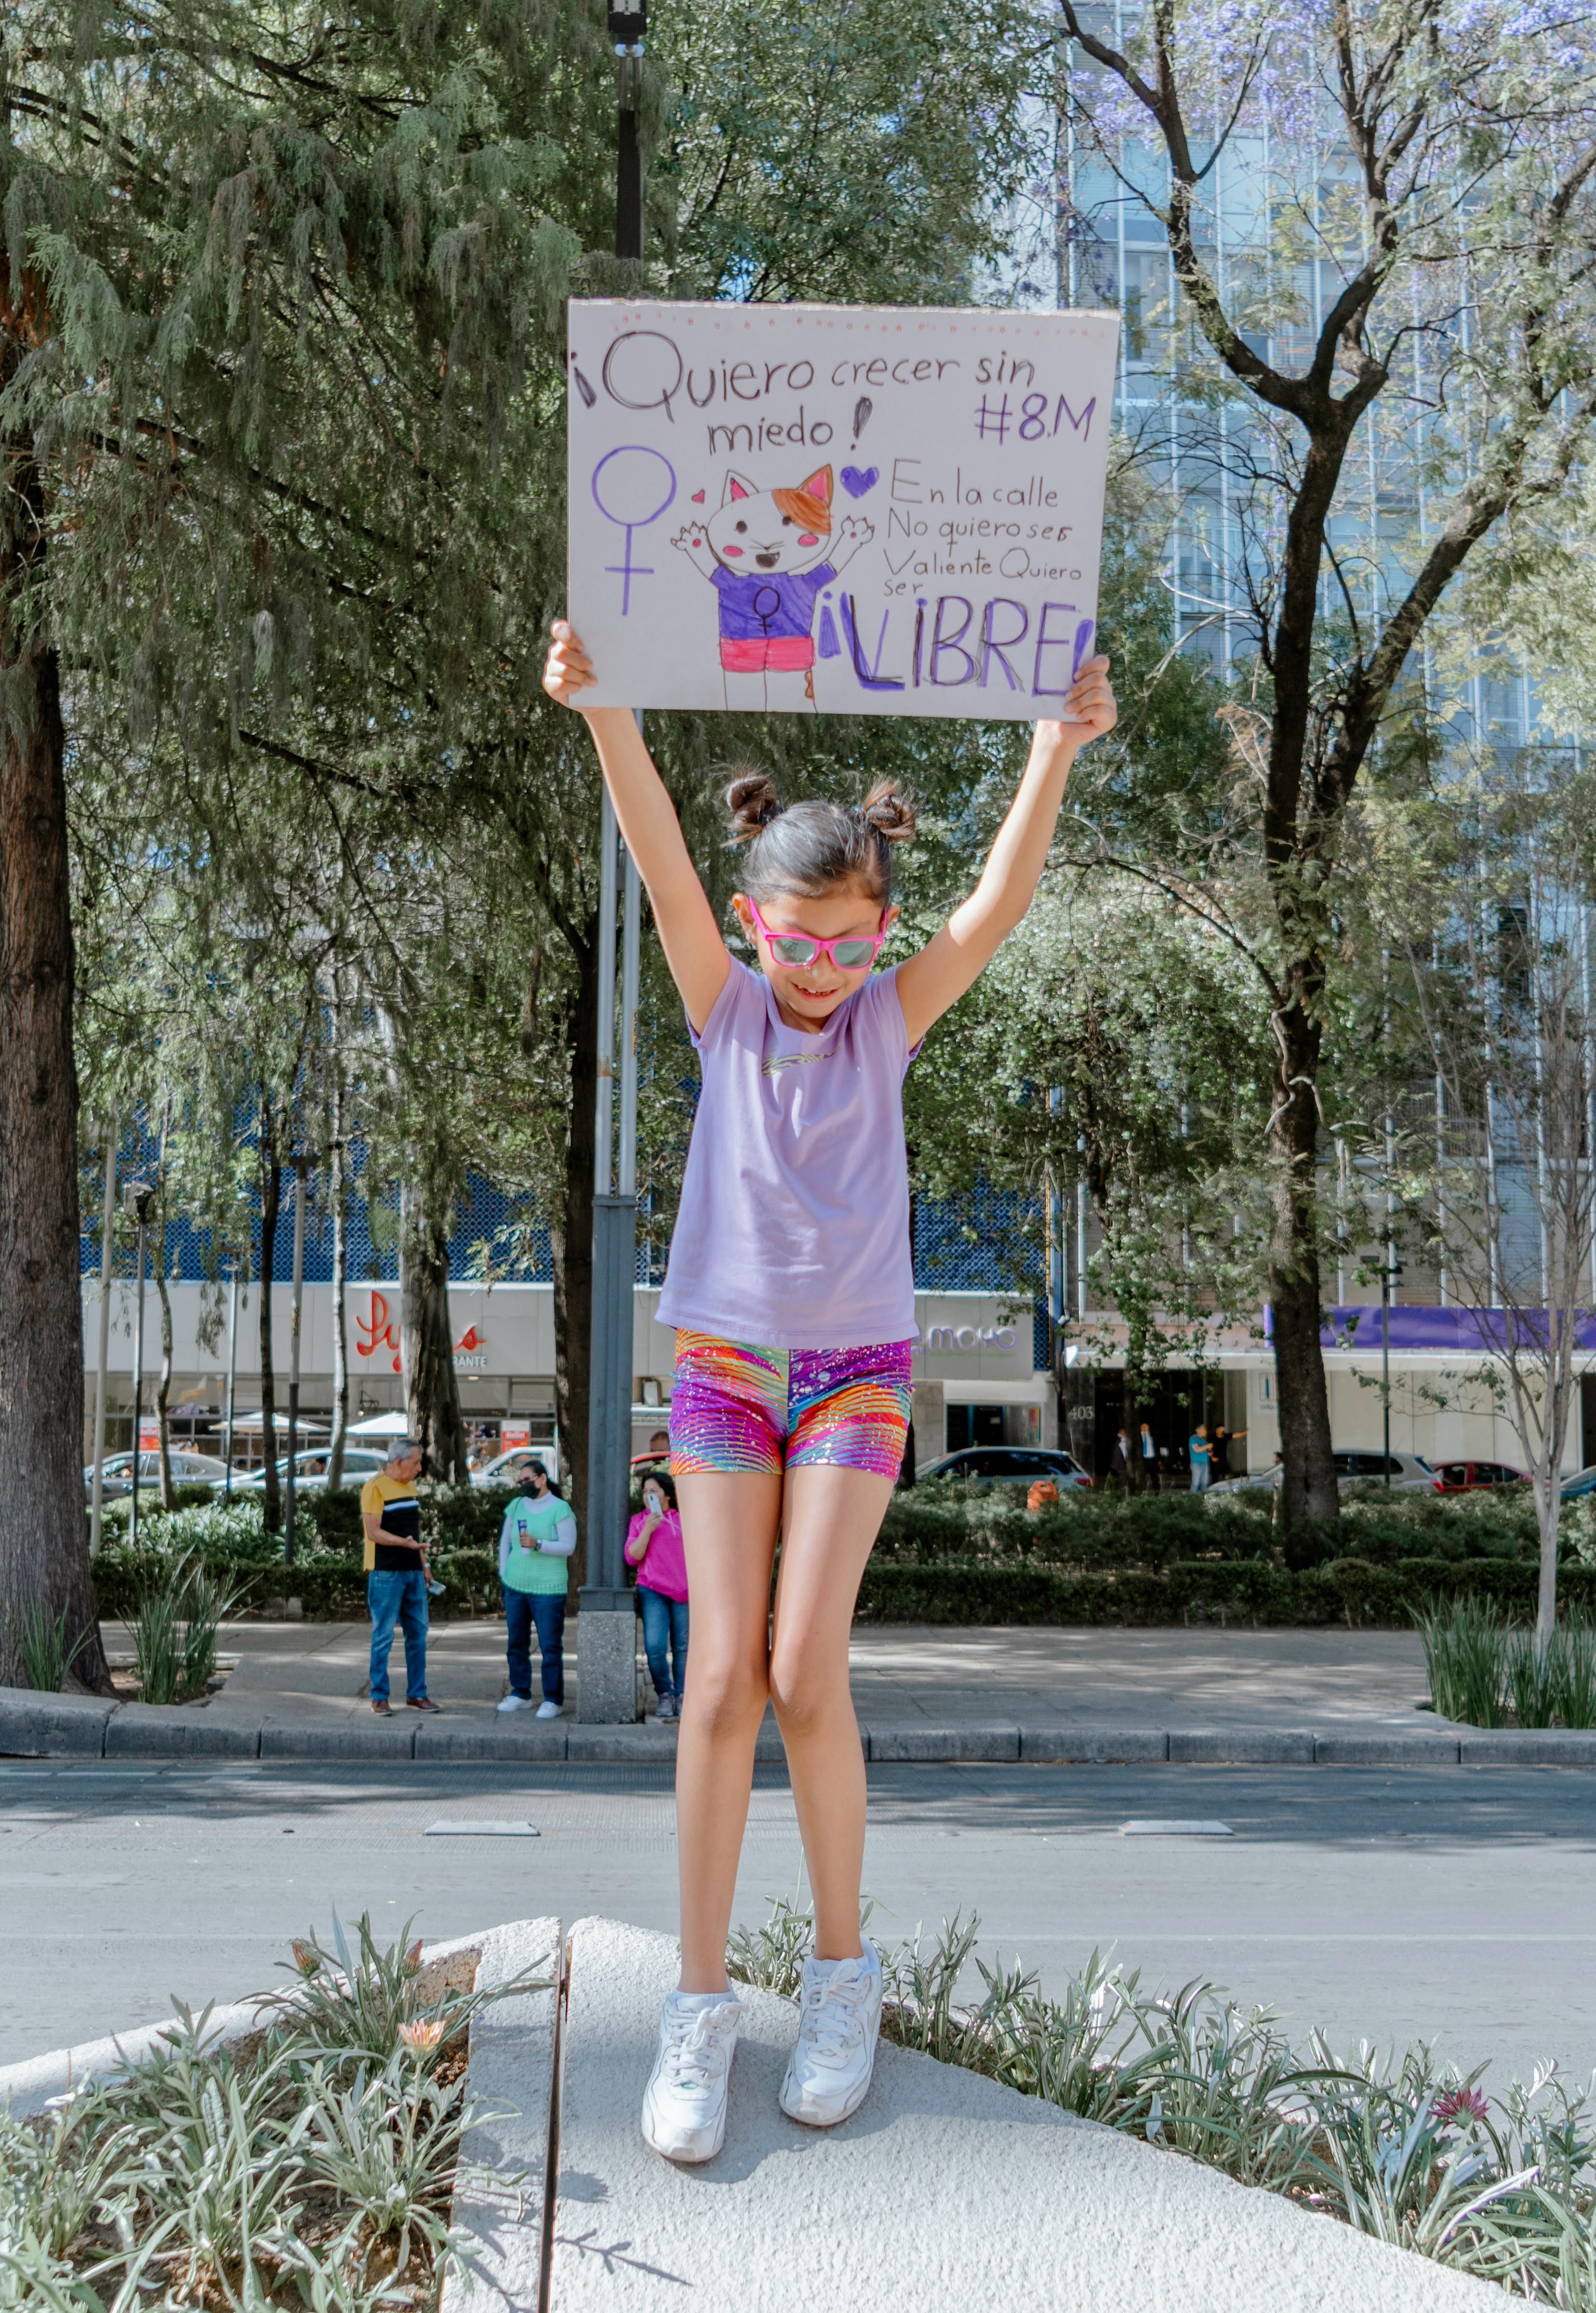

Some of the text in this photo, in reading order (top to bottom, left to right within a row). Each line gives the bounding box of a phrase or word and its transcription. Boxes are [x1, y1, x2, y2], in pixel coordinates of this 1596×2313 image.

[832, 357, 960, 386] crecer
[975, 351, 1035, 389] sin
[888, 507, 928, 538] No
[939, 518, 1020, 559] quiero
[883, 547, 1082, 580] Valiente Quiero
[1068, 1405, 1094, 1420] 403
